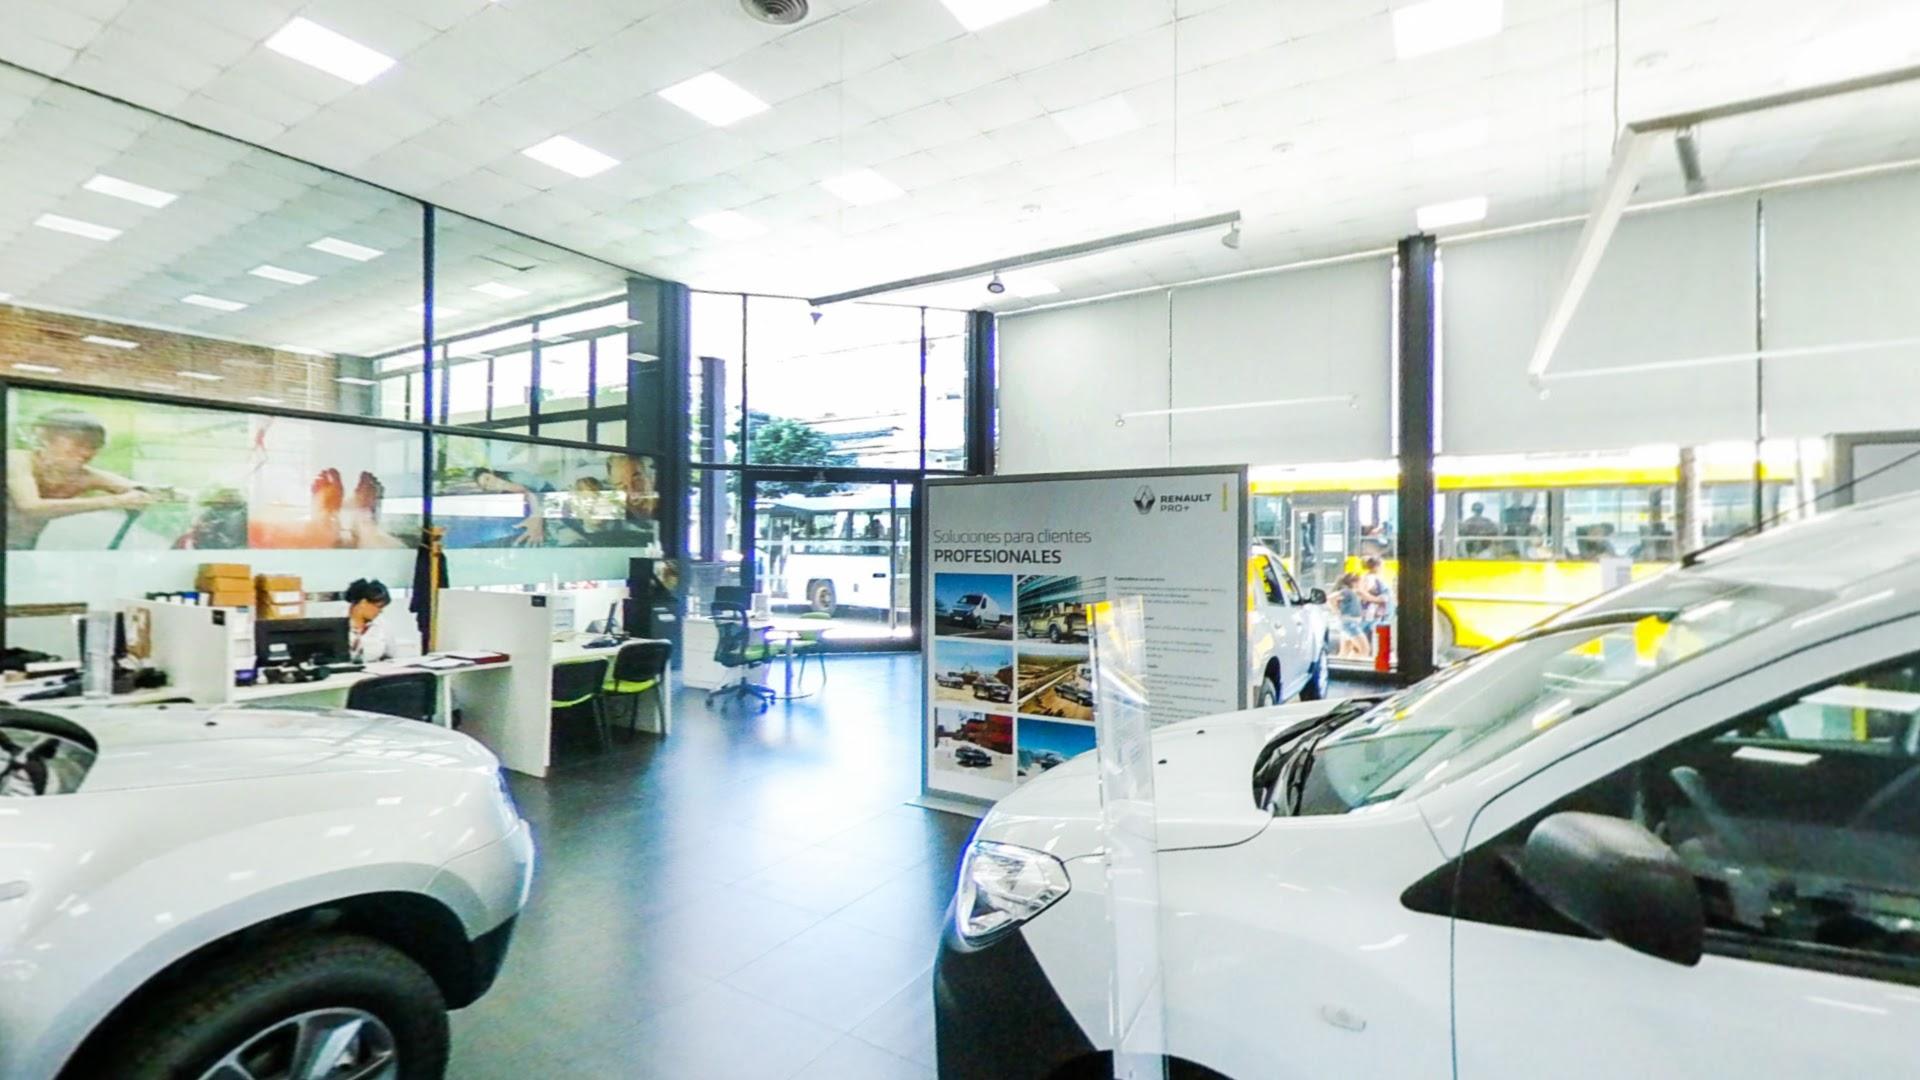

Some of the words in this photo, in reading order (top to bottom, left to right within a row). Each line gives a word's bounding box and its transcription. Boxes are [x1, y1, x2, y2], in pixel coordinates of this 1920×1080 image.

[1160, 493, 1212, 503] RENAULT
[1160, 504, 1190, 512] PRO+
[933, 529, 1000, 544] Soluciones
[1004, 531, 1034, 546] para
[1037, 528, 1092, 544] clientes
[934, 549, 1062, 564] PROFESIONALES
